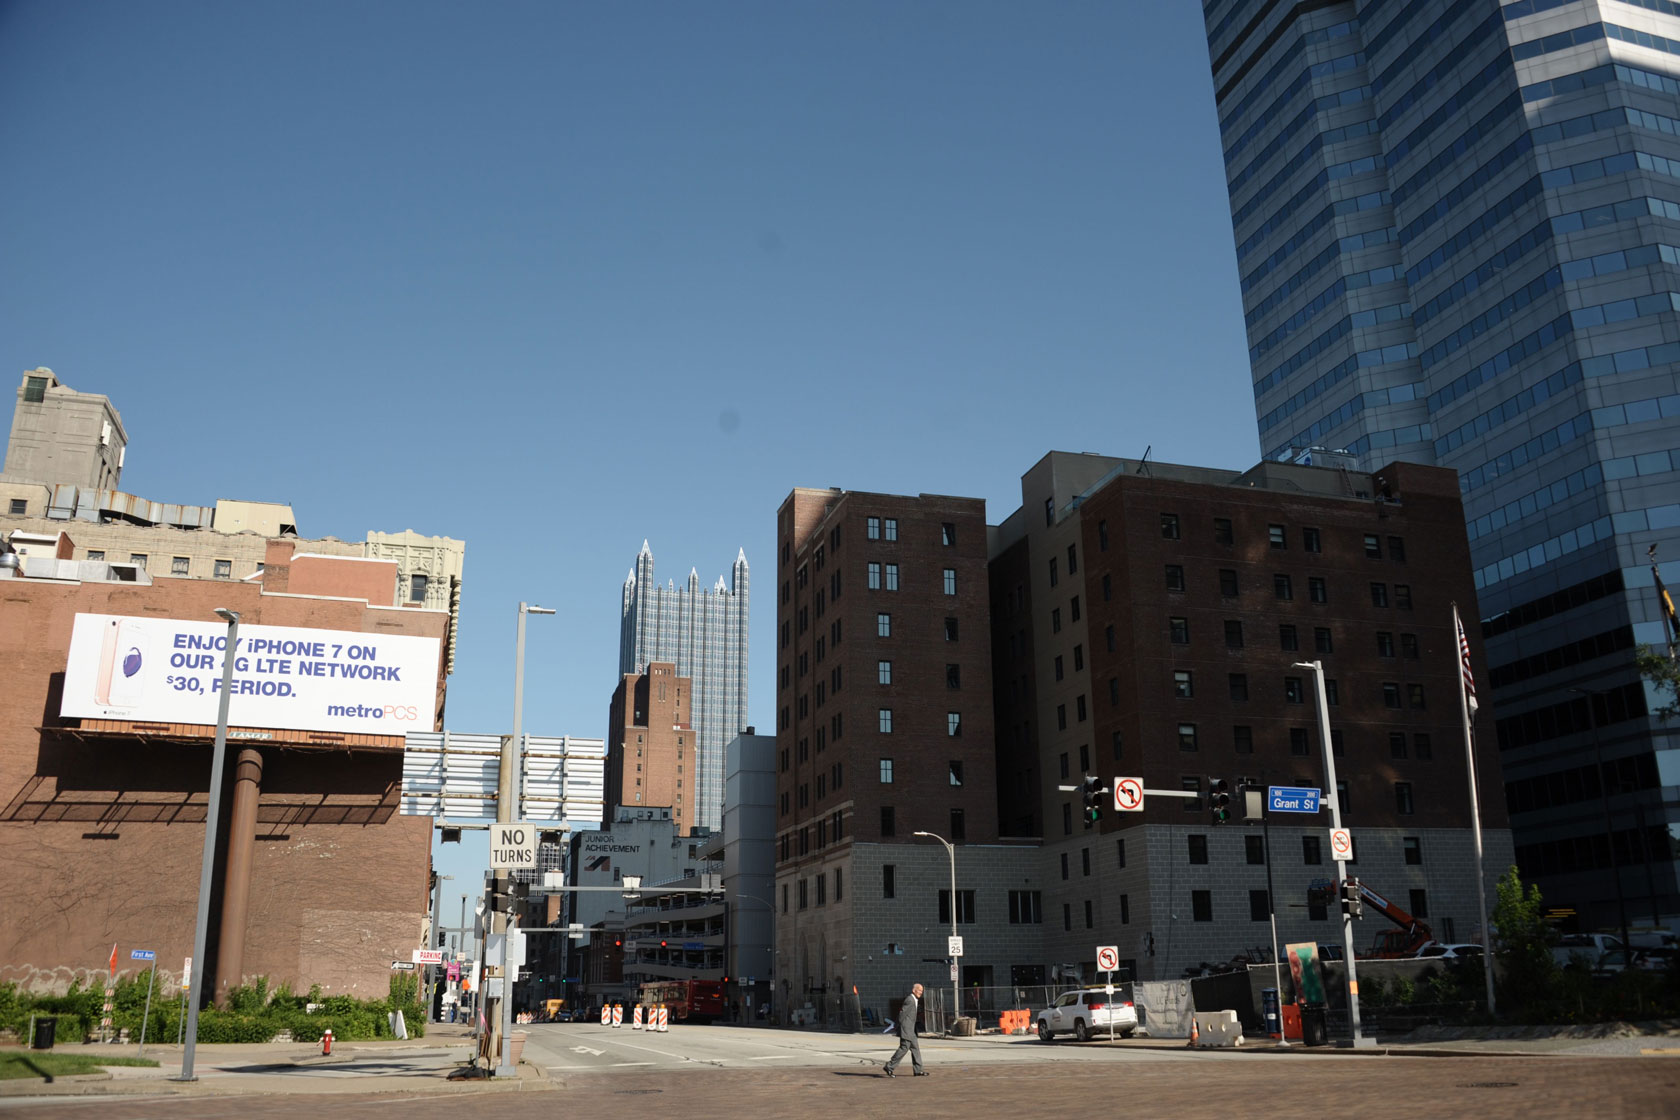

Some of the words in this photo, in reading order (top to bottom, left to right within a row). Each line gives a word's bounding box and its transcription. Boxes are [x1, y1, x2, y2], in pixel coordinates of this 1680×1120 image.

[247, 638, 326, 658] iPHONE
[331, 644, 343, 658] 7
[347, 645, 376, 661] ON
[170, 653, 215, 670] OUR
[221, 656, 249, 672] G
[256, 658, 292, 675] LTE
[298, 661, 401, 681] NETWORK
[211, 678, 297, 698] PERIOD.
[327, 704, 418, 720] metroPCS
[1274, 797, 1299, 809] Grant
[1303, 799, 1314, 810] St
[502, 829, 525, 845] NO
[585, 835, 615, 843] JUNIOR
[493, 849, 532, 863] TURNS
[585, 844, 640, 853] ACHIEVEMENT
[419, 951, 442, 960] PARKING
